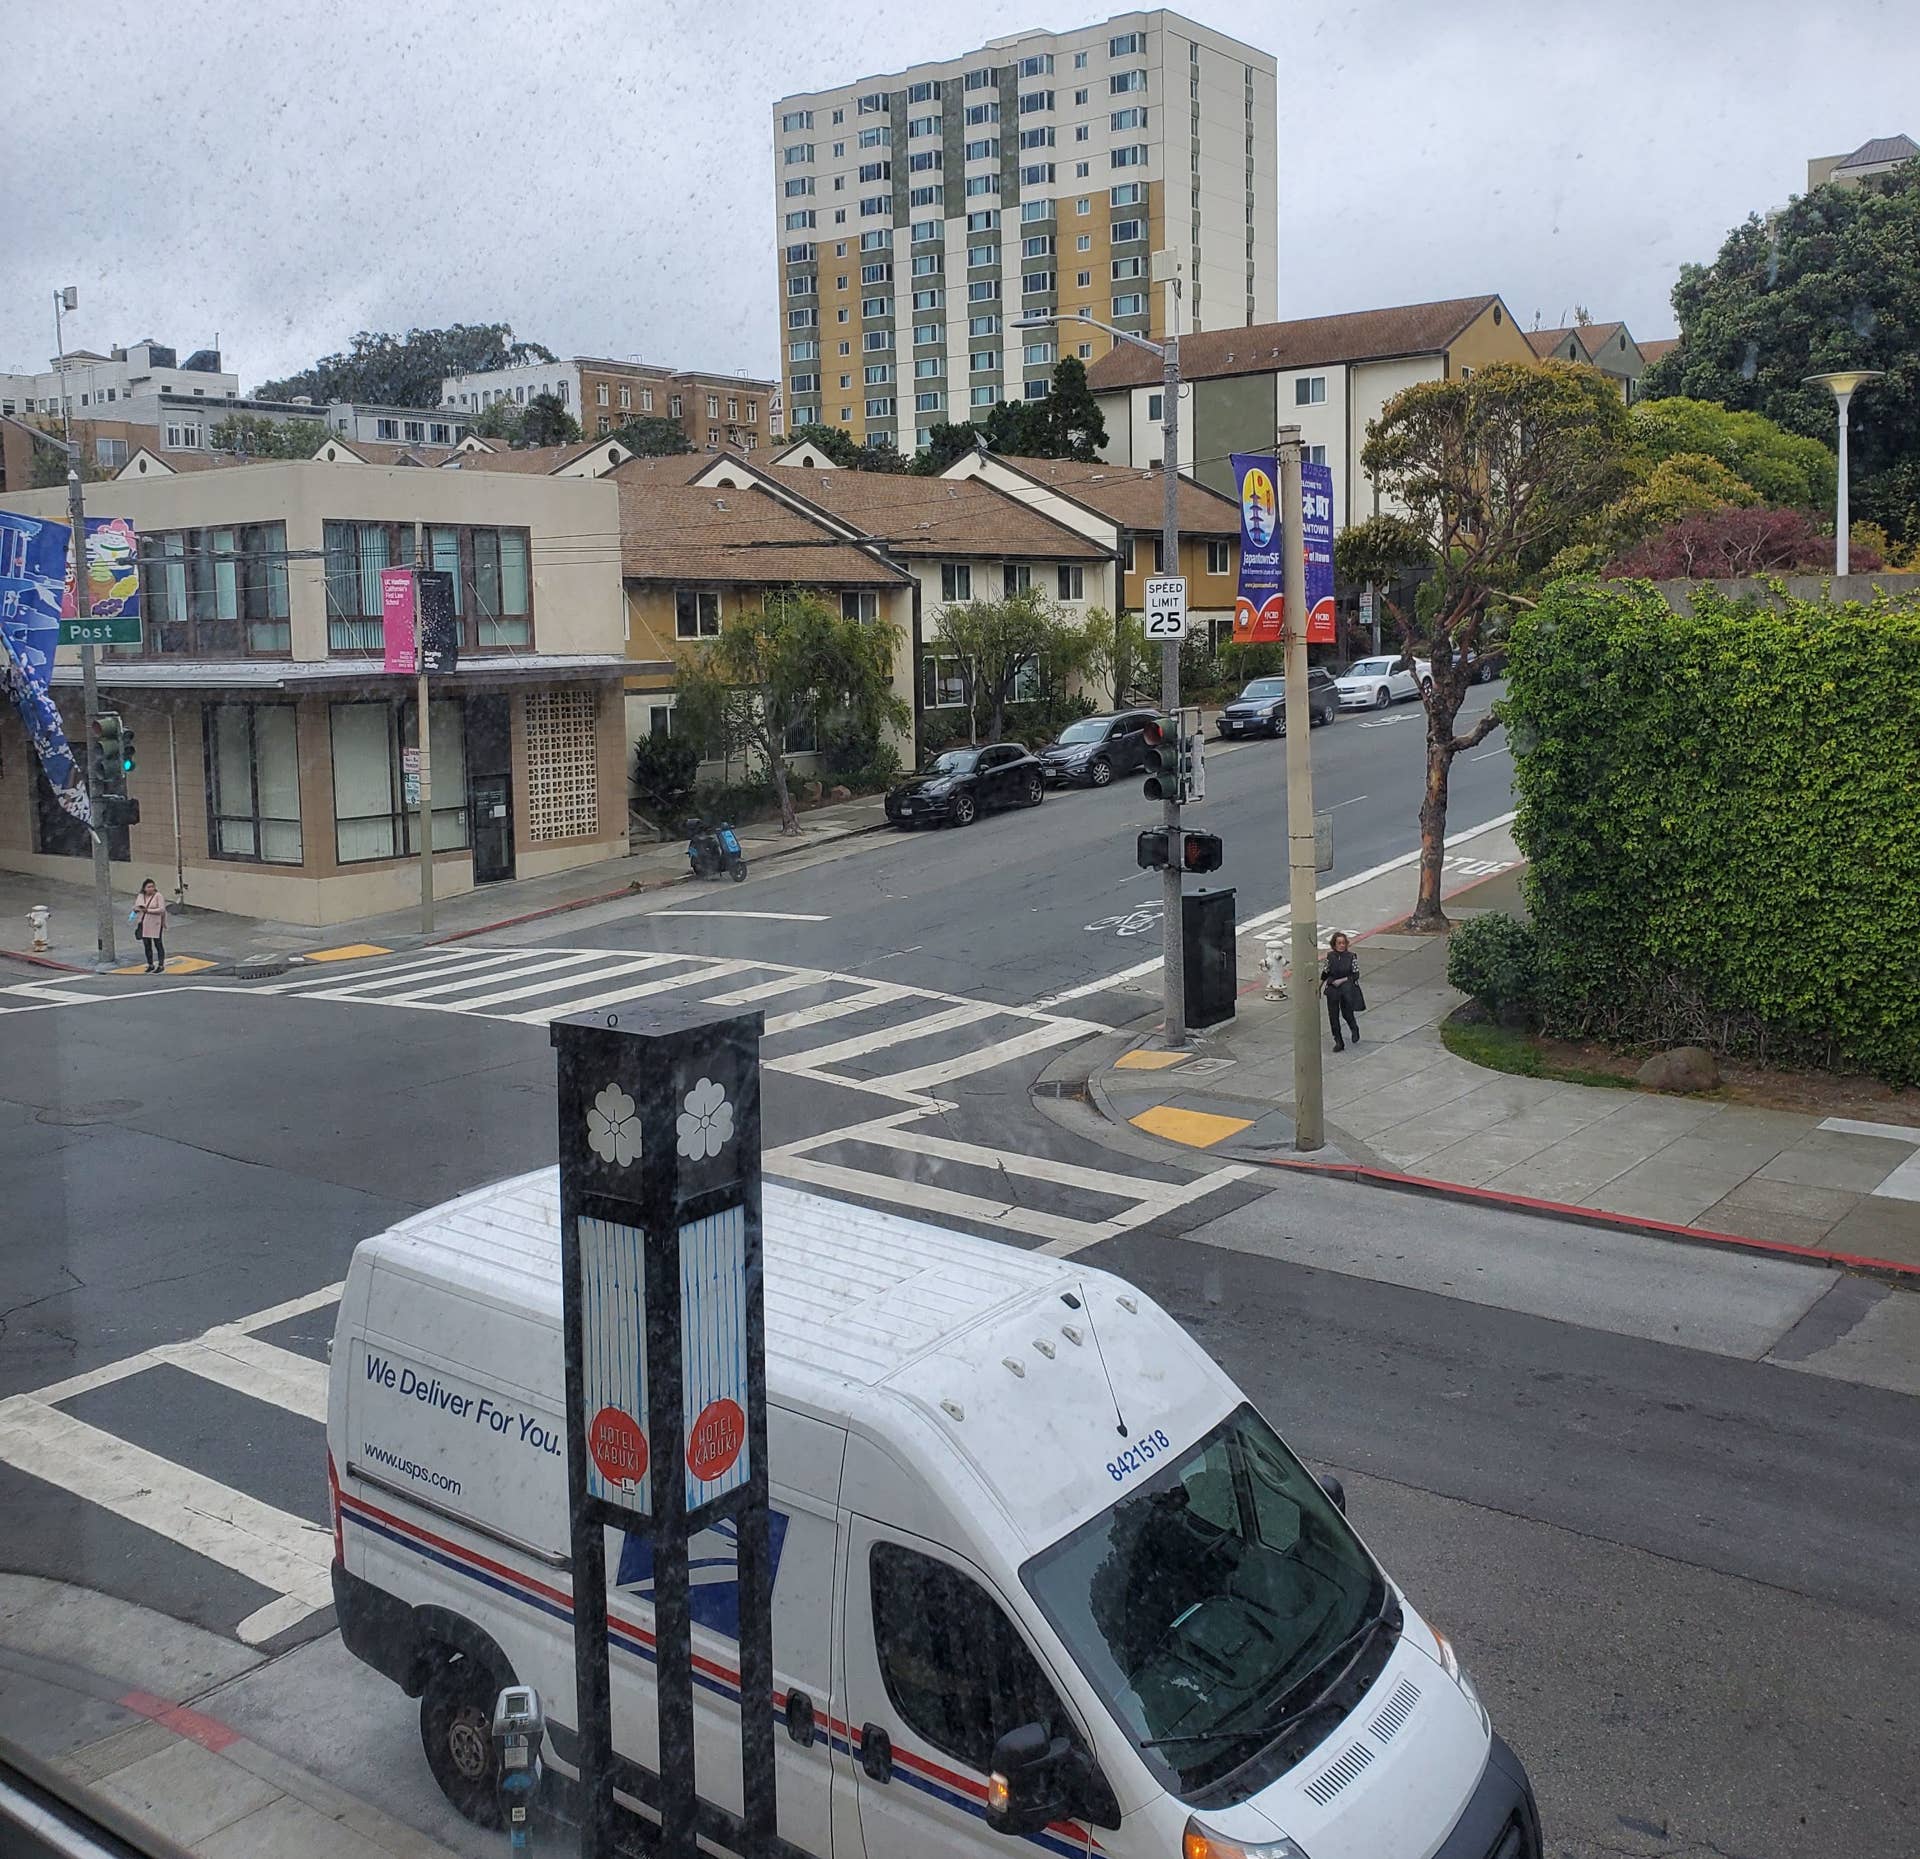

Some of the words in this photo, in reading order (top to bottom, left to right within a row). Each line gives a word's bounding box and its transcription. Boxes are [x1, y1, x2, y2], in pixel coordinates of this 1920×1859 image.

[1300, 480, 1316, 489] ELCOME
[1302, 493, 1330, 520] 本町
[1302, 522, 1329, 535] ANTOWN
[1243, 551, 1280, 566] JapantownSF
[1149, 583, 1183, 593] SPEED
[1152, 597, 1179, 607] LIMIT
[70, 624, 112, 639] Post
[1150, 611, 1181, 632] 25
[367, 1354, 396, 1388] We
[400, 1368, 473, 1418] Deliver
[476, 1399, 514, 1434] For
[519, 1413, 561, 1456] You.
[600, 1424, 635, 1451] HOTEL
[699, 1415, 733, 1443] HOTEL
[596, 1441, 639, 1471] KABUKI
[694, 1432, 737, 1466] KABUKI
[1106, 1429, 1169, 1481] 8421518
[364, 1442, 461, 1496] www.usps.com
